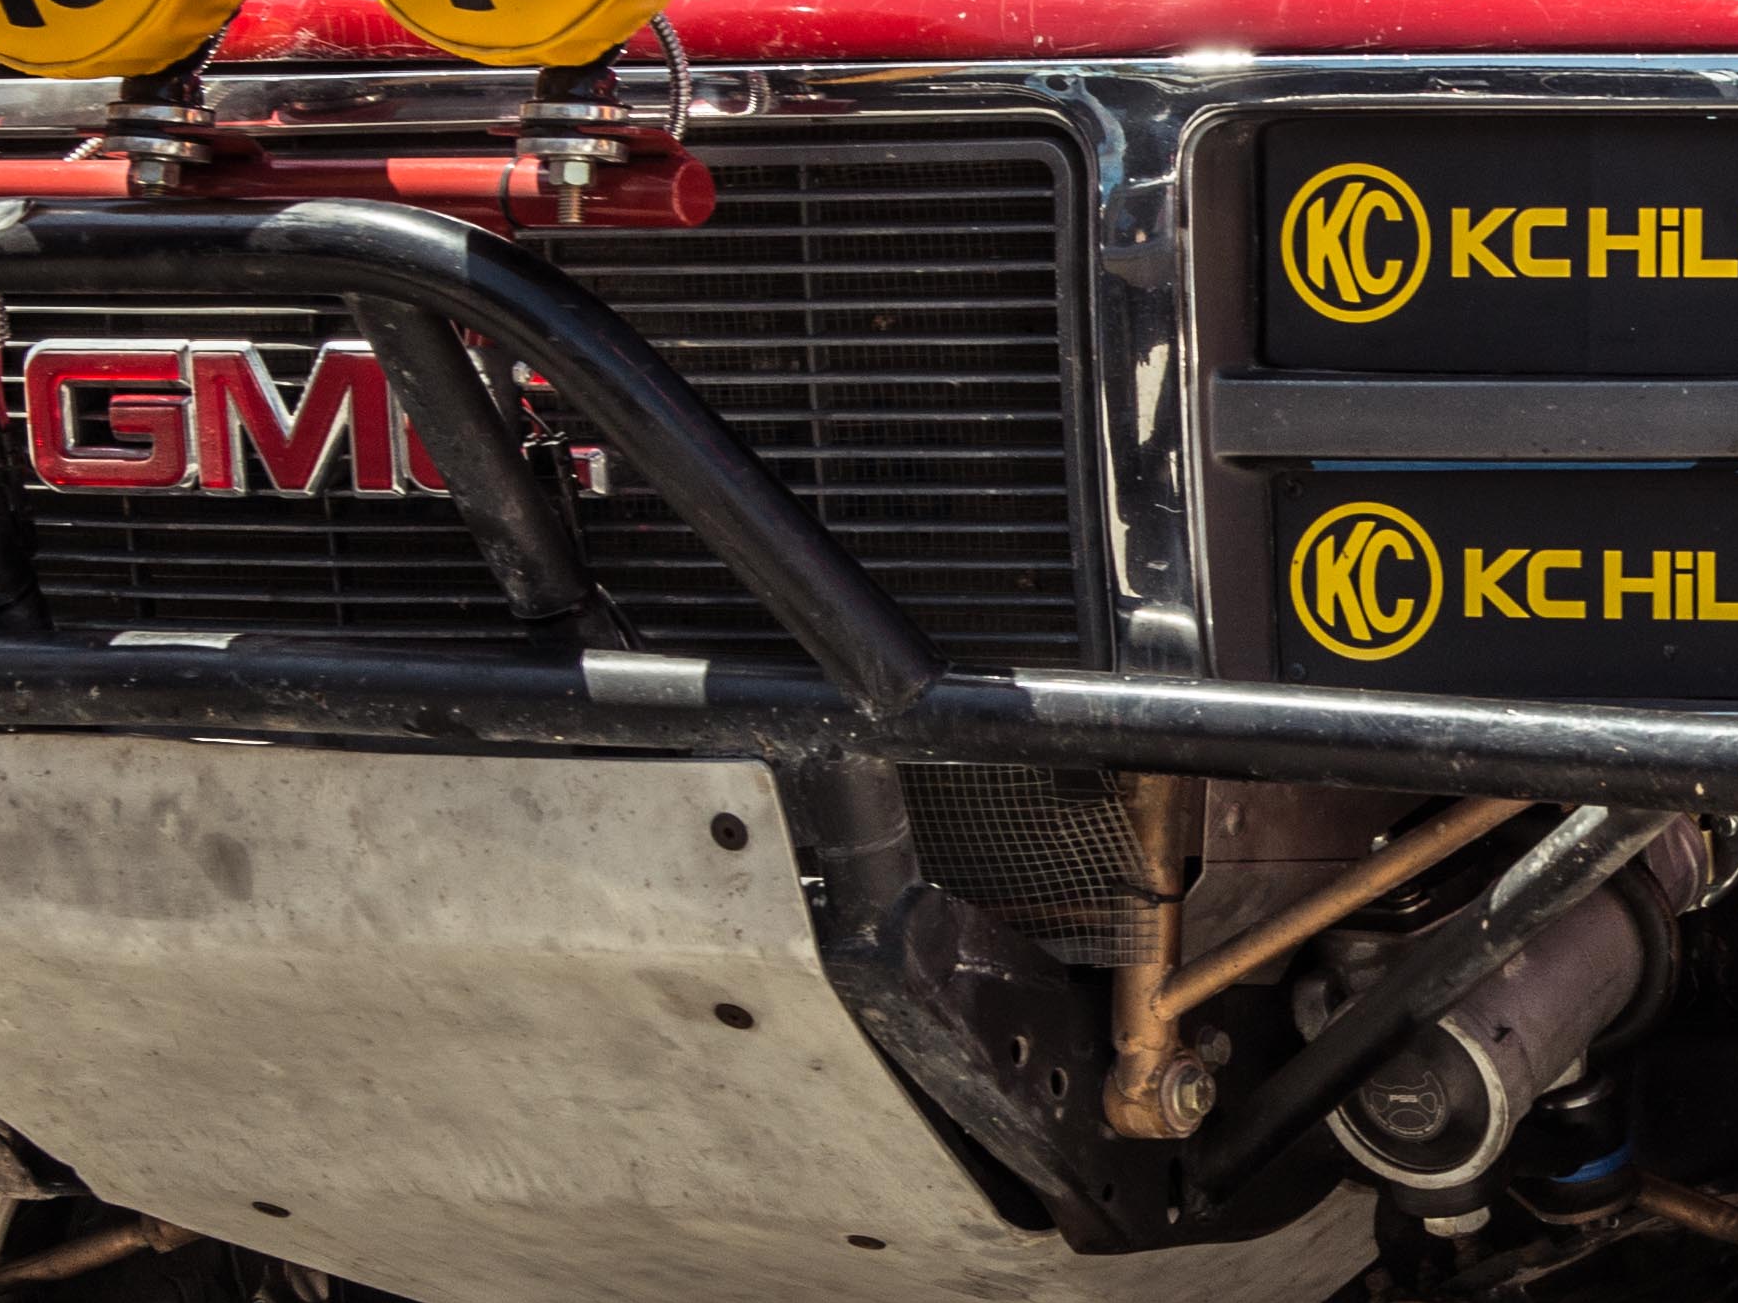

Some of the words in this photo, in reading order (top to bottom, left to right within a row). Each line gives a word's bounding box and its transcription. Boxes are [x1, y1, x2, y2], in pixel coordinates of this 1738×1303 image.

[1306, 182, 1403, 304] KC
[1451, 207, 1570, 279] KC
[25, 338, 608, 498] GM
[1316, 519, 1416, 643] KC
[1464, 548, 1587, 619] KC
